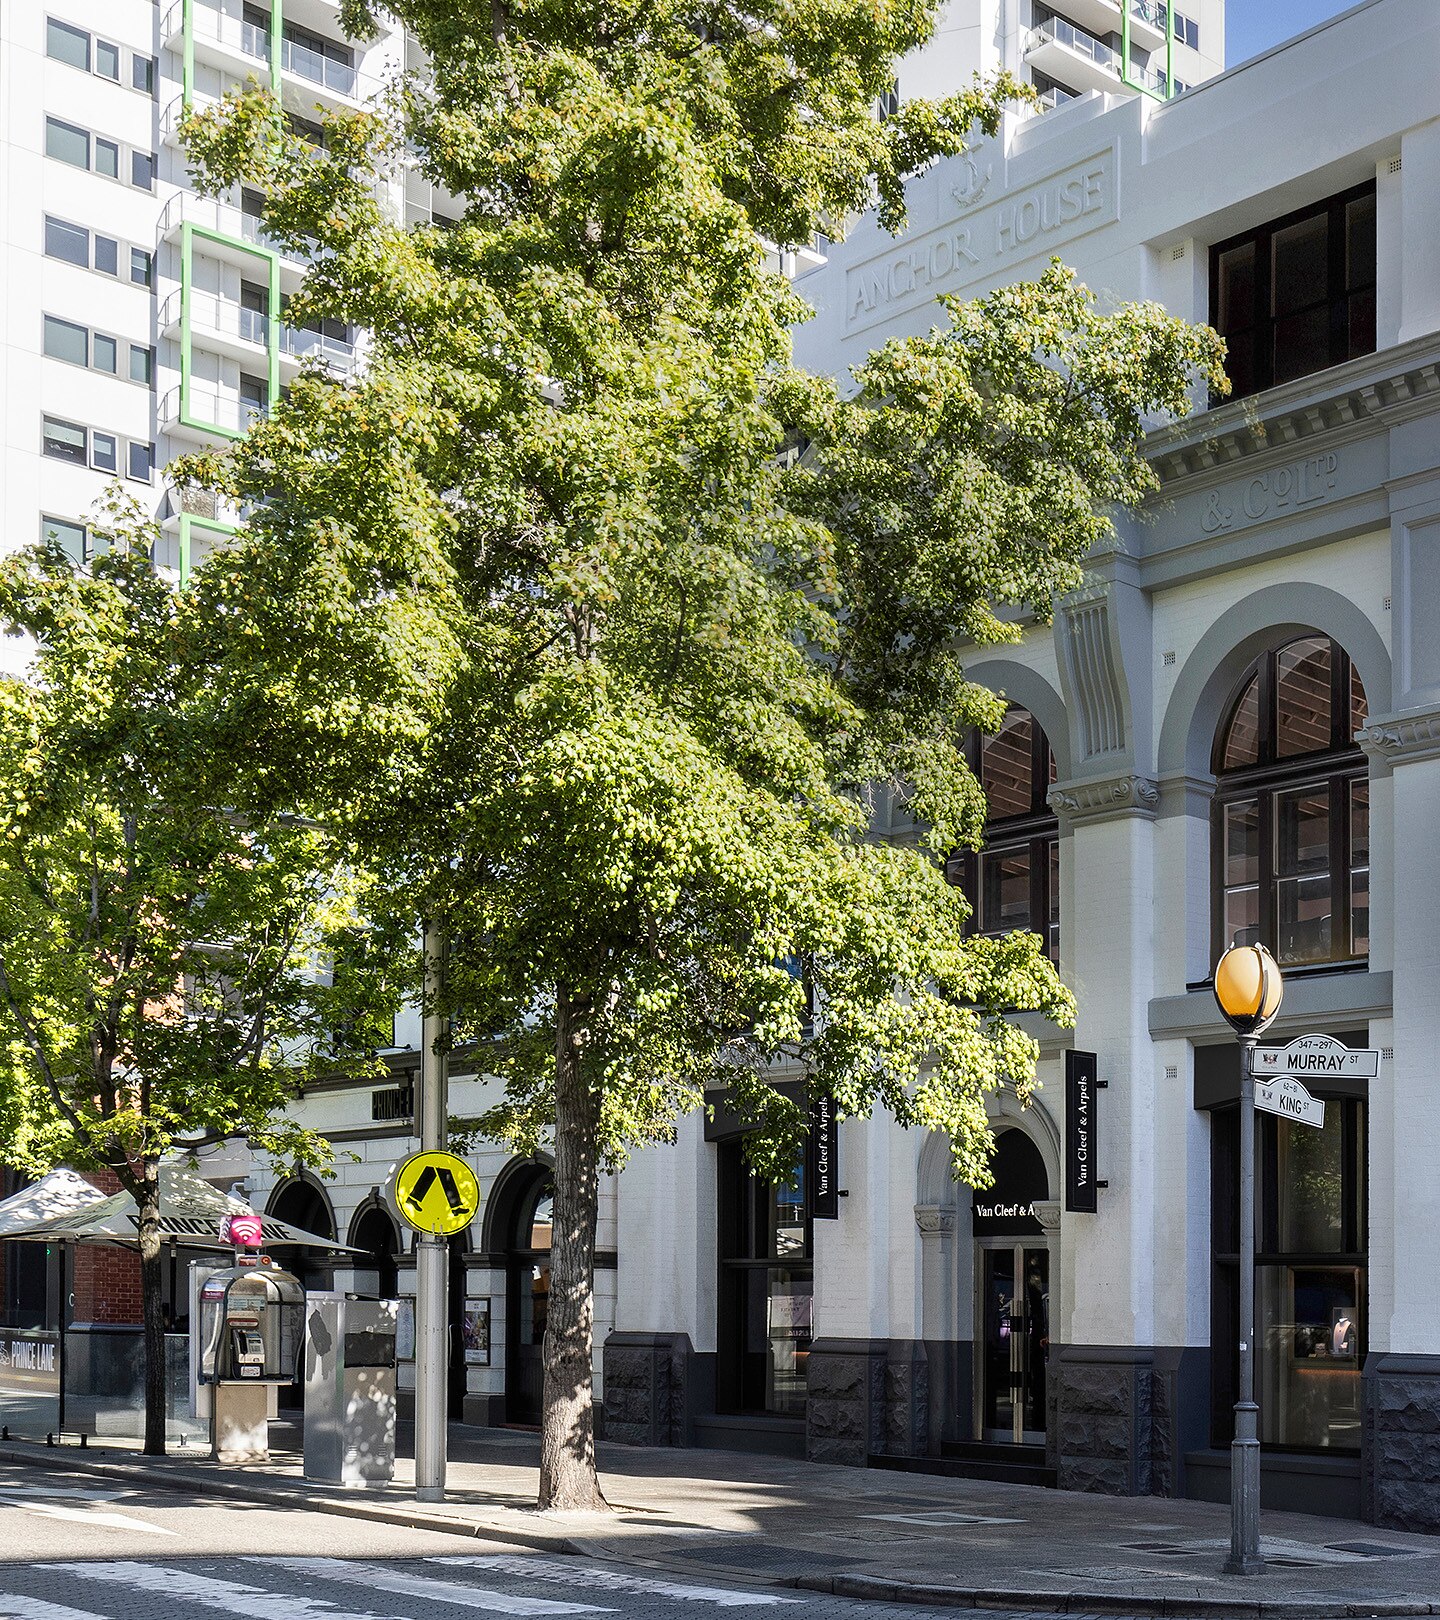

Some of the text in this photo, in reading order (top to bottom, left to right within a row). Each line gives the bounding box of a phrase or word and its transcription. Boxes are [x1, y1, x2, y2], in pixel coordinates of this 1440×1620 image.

[850, 167, 1104, 322] ANCHOR HOUSE
[1200, 489, 1232, 533] &
[1287, 1053, 1359, 1071] MURRAY ST
[1279, 1094, 1310, 1115] KING ST
[818, 1096, 831, 1196] Van Cleef & Arpels
[1077, 1075, 1090, 1187] Van Cleef & Arpels
[976, 1204, 993, 1217] Van
[994, 1203, 1018, 1217] Cleef
[1019, 1205, 1027, 1216] &
[11, 1340, 55, 1372] PRINCE LANE
